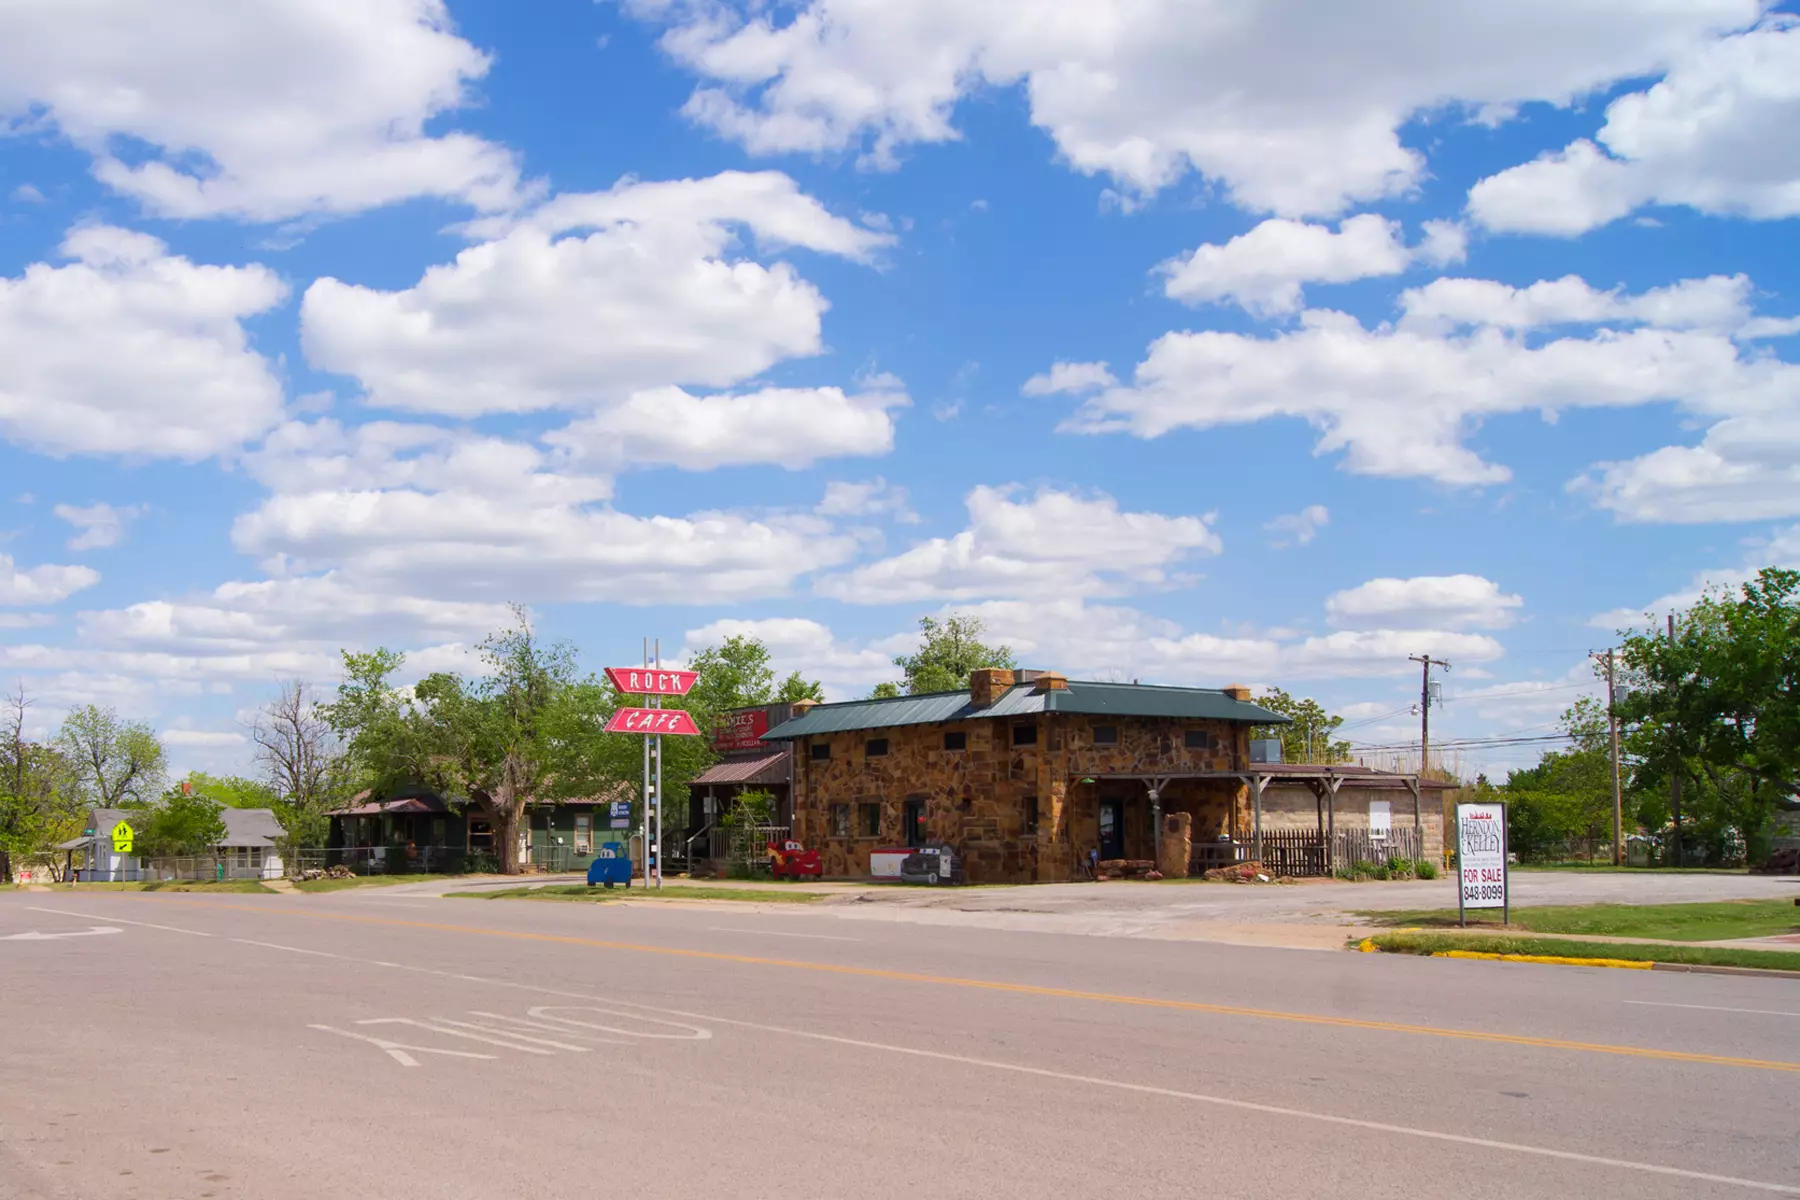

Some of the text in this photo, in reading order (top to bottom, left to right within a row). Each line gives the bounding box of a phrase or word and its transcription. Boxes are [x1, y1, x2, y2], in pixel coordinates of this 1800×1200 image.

[629, 672, 682, 691] ROCK
[626, 711, 682, 730] CAFE
[1460, 816, 1501, 839] HERNDON
[1467, 833, 1500, 856] KELLEY
[1463, 868, 1502, 883] FOR SALE
[1463, 885, 1503, 900] 848-8099
